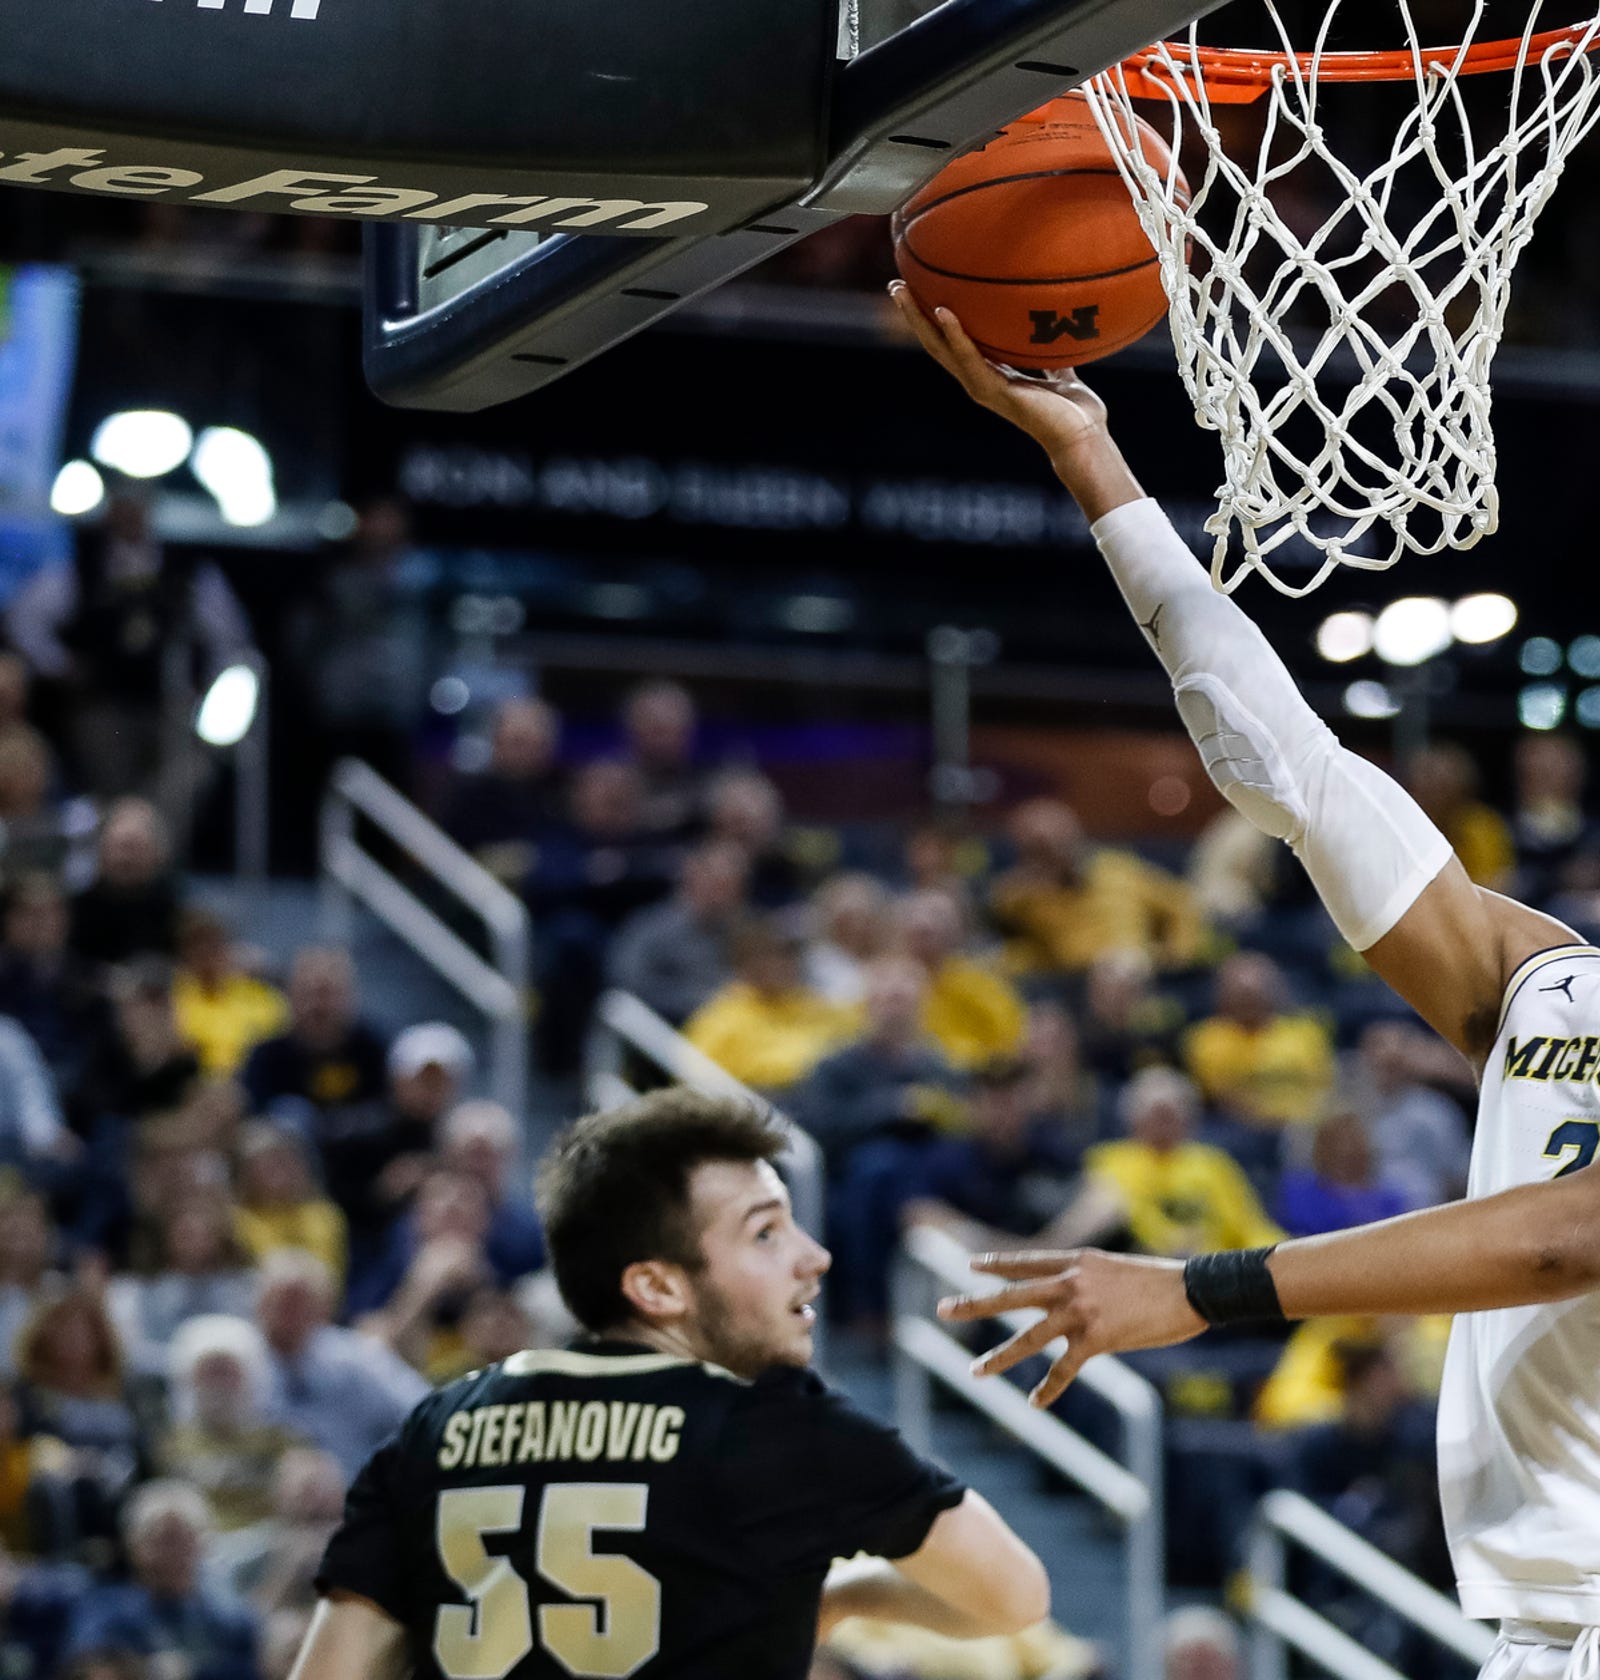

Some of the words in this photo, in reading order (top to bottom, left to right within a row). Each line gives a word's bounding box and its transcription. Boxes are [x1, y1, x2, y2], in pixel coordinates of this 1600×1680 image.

[0, 148, 204, 195] te
[188, 168, 710, 230] Farm
[437, 1400, 686, 1470] STEFANOVIC
[434, 1482, 662, 1680] 55
